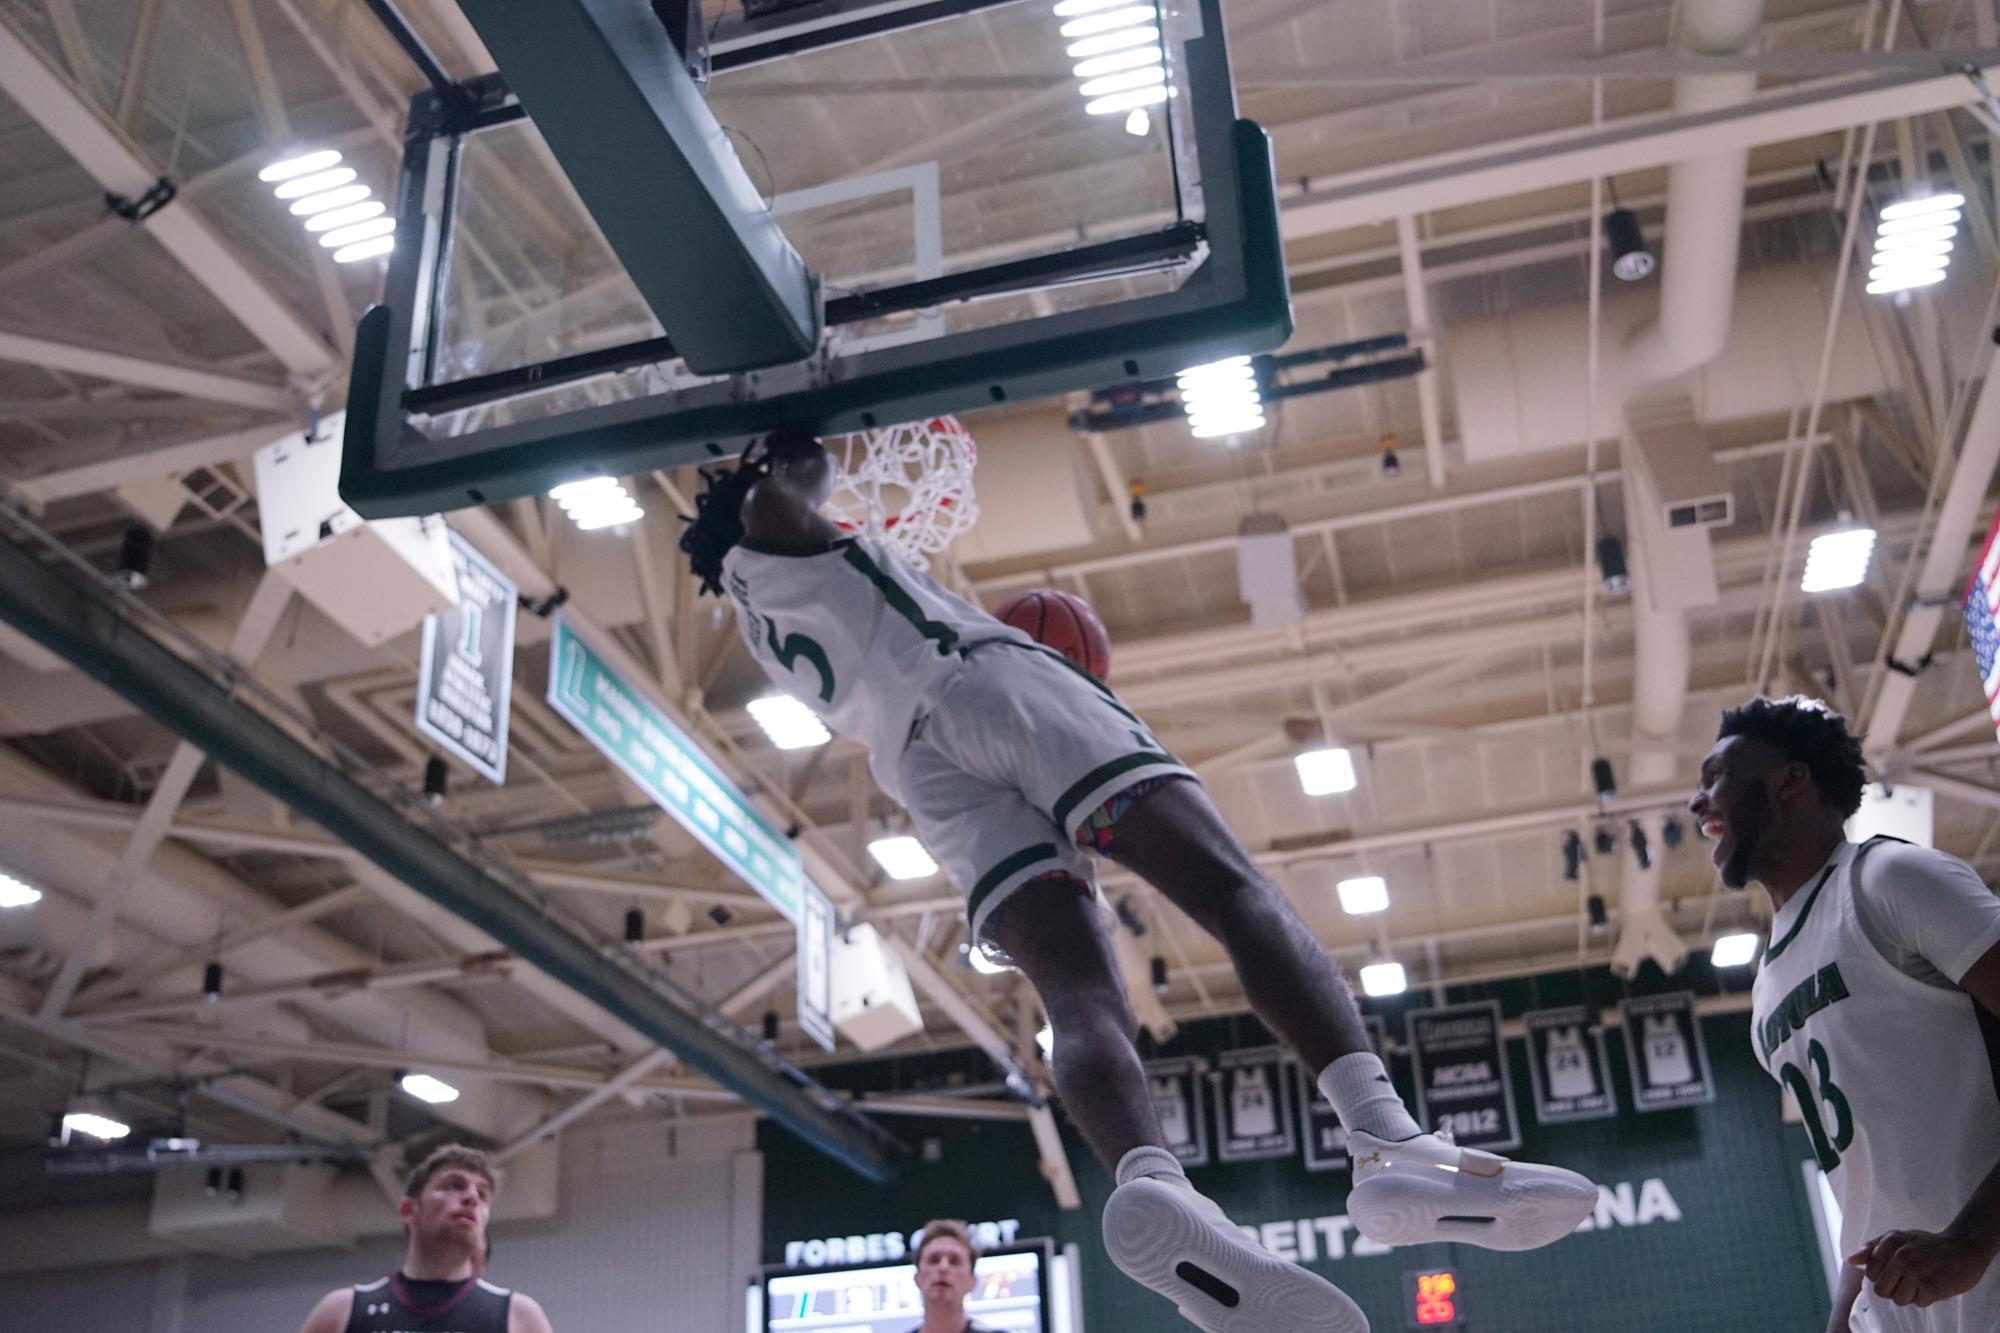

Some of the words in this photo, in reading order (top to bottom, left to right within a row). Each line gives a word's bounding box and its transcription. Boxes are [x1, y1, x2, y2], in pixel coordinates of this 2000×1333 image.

[762, 613, 836, 704] 5
[1437, 1108, 1500, 1136] 2012
[785, 1231, 905, 1269] FORBES
